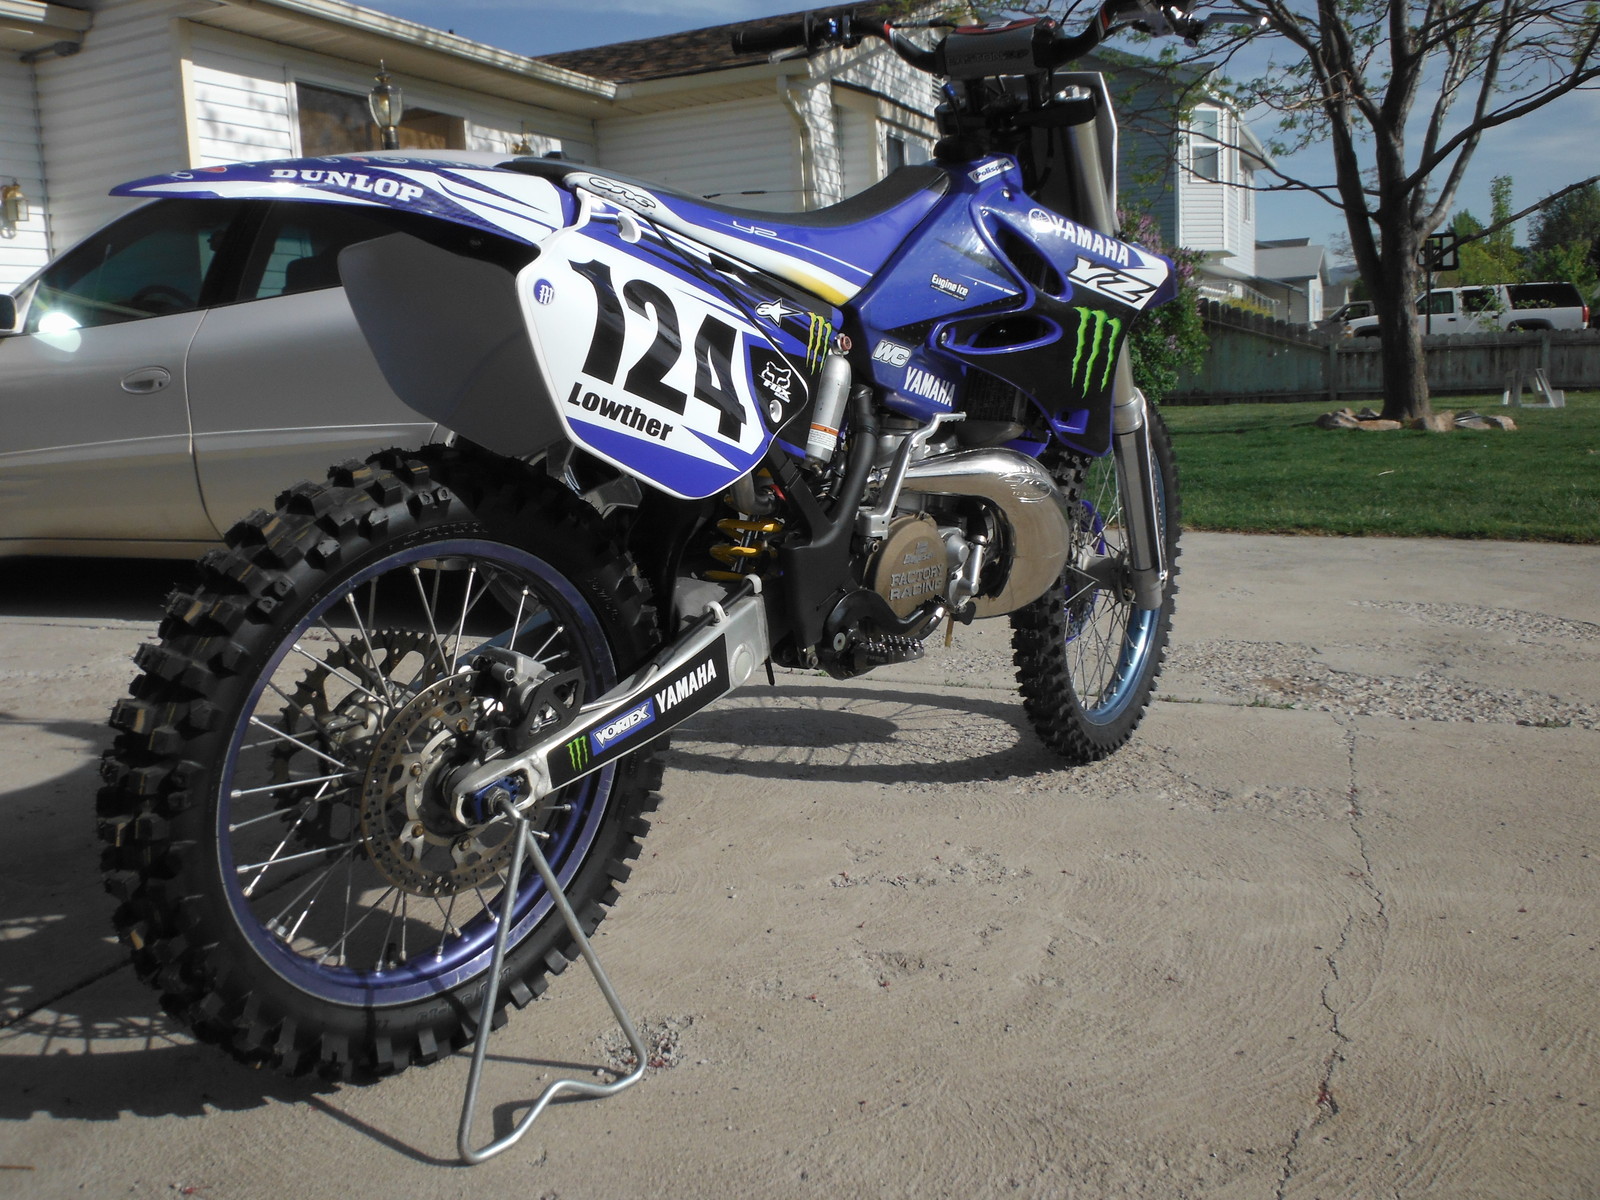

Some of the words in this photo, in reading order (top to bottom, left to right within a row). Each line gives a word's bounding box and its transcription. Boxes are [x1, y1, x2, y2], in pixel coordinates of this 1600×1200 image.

[269, 168, 424, 202] DUNLOP
[1050, 215, 1129, 267] YAMAHA
[931, 273, 958, 292] Engine
[956, 284, 969, 296] Ice
[1067, 255, 1157, 304] YZ
[567, 258, 748, 443] 124
[763, 379, 792, 399] FOX
[903, 365, 956, 407] YAMAHA
[567, 382, 673, 441] Lowther
[888, 579, 943, 601] RACING
[889, 563, 944, 587] FACTORY
[655, 658, 717, 714] YAMAHA
[592, 700, 652, 749] VORTEX
